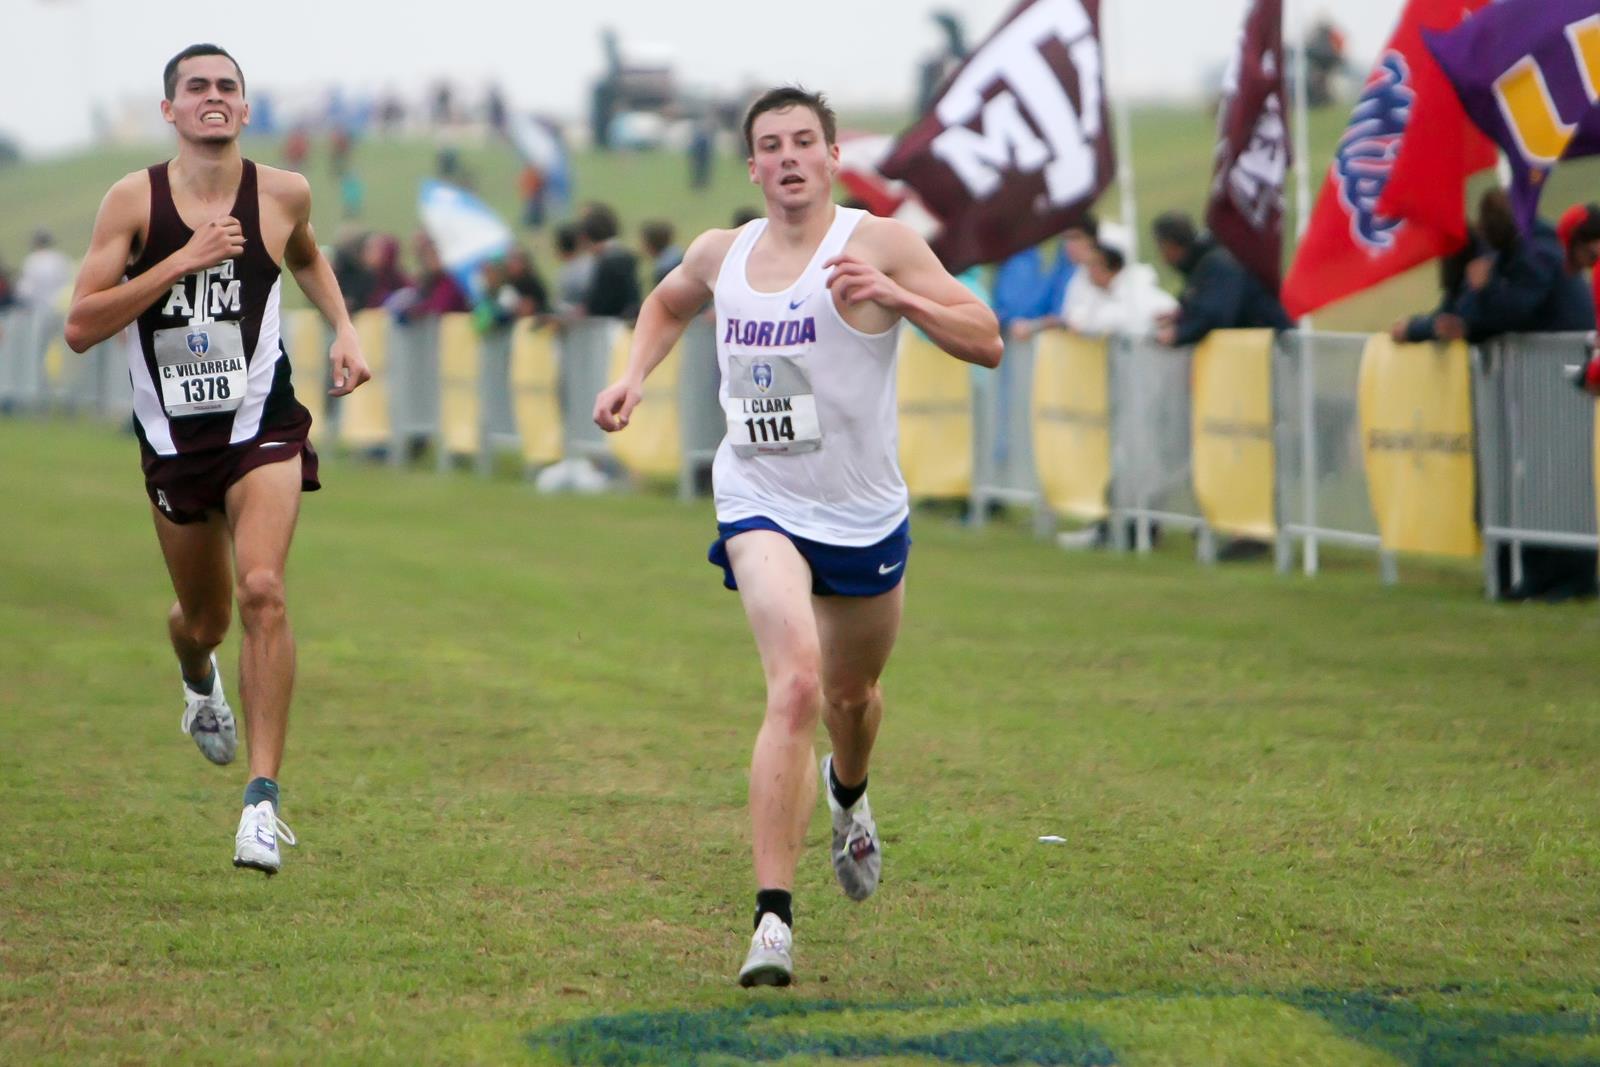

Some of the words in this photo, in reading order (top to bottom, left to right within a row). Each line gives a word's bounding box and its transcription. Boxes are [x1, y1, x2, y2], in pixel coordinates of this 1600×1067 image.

[724, 316, 817, 347] FLORIDA
[163, 365, 175, 379] C.
[177, 359, 243, 378] VILLARREAL
[180, 375, 231, 403] 1378
[751, 397, 793, 413] CLARK
[745, 415, 795, 443] 1114
